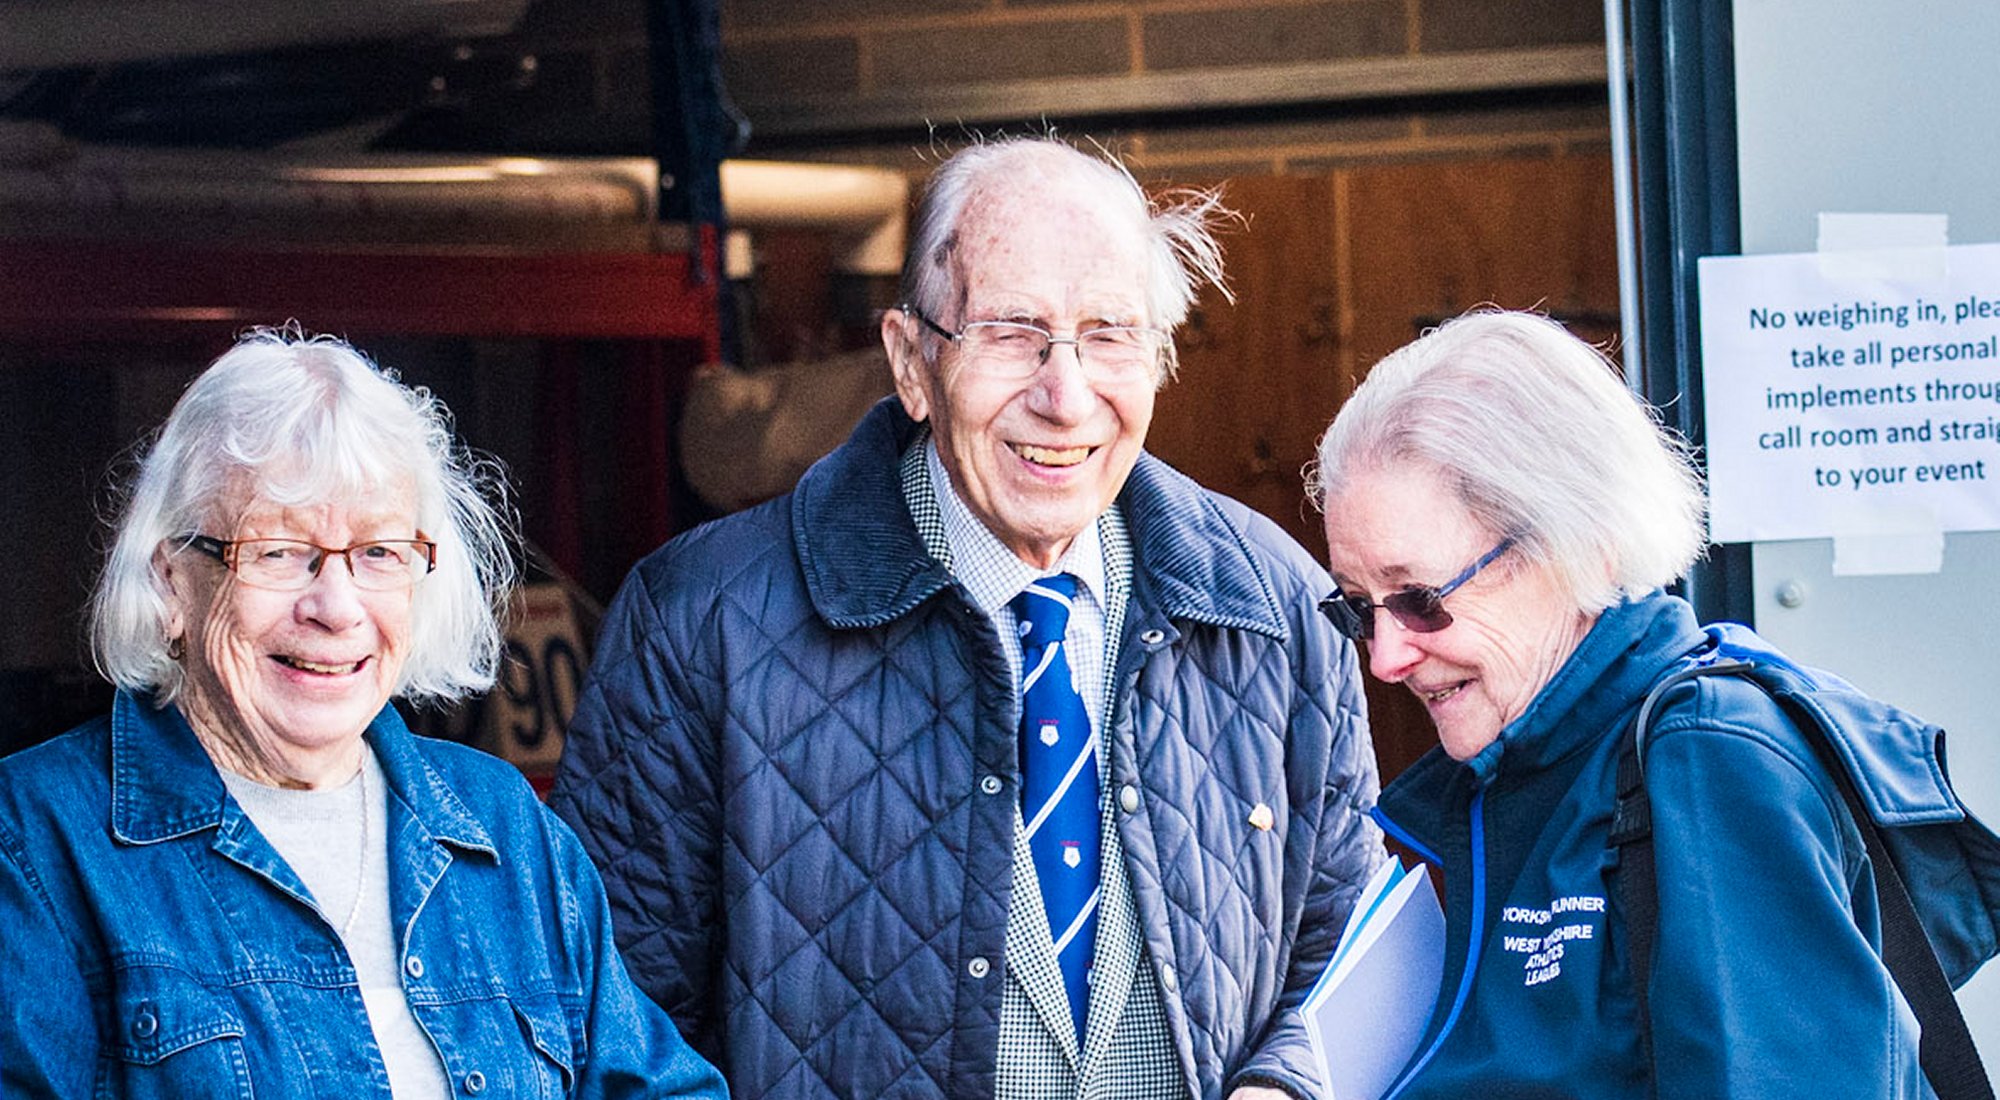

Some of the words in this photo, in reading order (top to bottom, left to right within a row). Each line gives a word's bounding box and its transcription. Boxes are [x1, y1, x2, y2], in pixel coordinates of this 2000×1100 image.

[1750, 308, 1786, 329] No
[1794, 301, 1909, 331] weighing
[1916, 299, 1947, 324] in,
[1790, 344, 1845, 368] take
[1853, 341, 1882, 366] all
[1890, 335, 1997, 369] personal
[1767, 383, 1917, 413] implements
[1759, 425, 1801, 450] call
[1810, 427, 1878, 447] room
[1886, 419, 1932, 444] and
[1815, 467, 1841, 487] to
[1850, 466, 1907, 491] your
[1915, 460, 1986, 483] event
[1503, 907, 1552, 925] YORKSH
[1504, 936, 1542, 953] WEST
